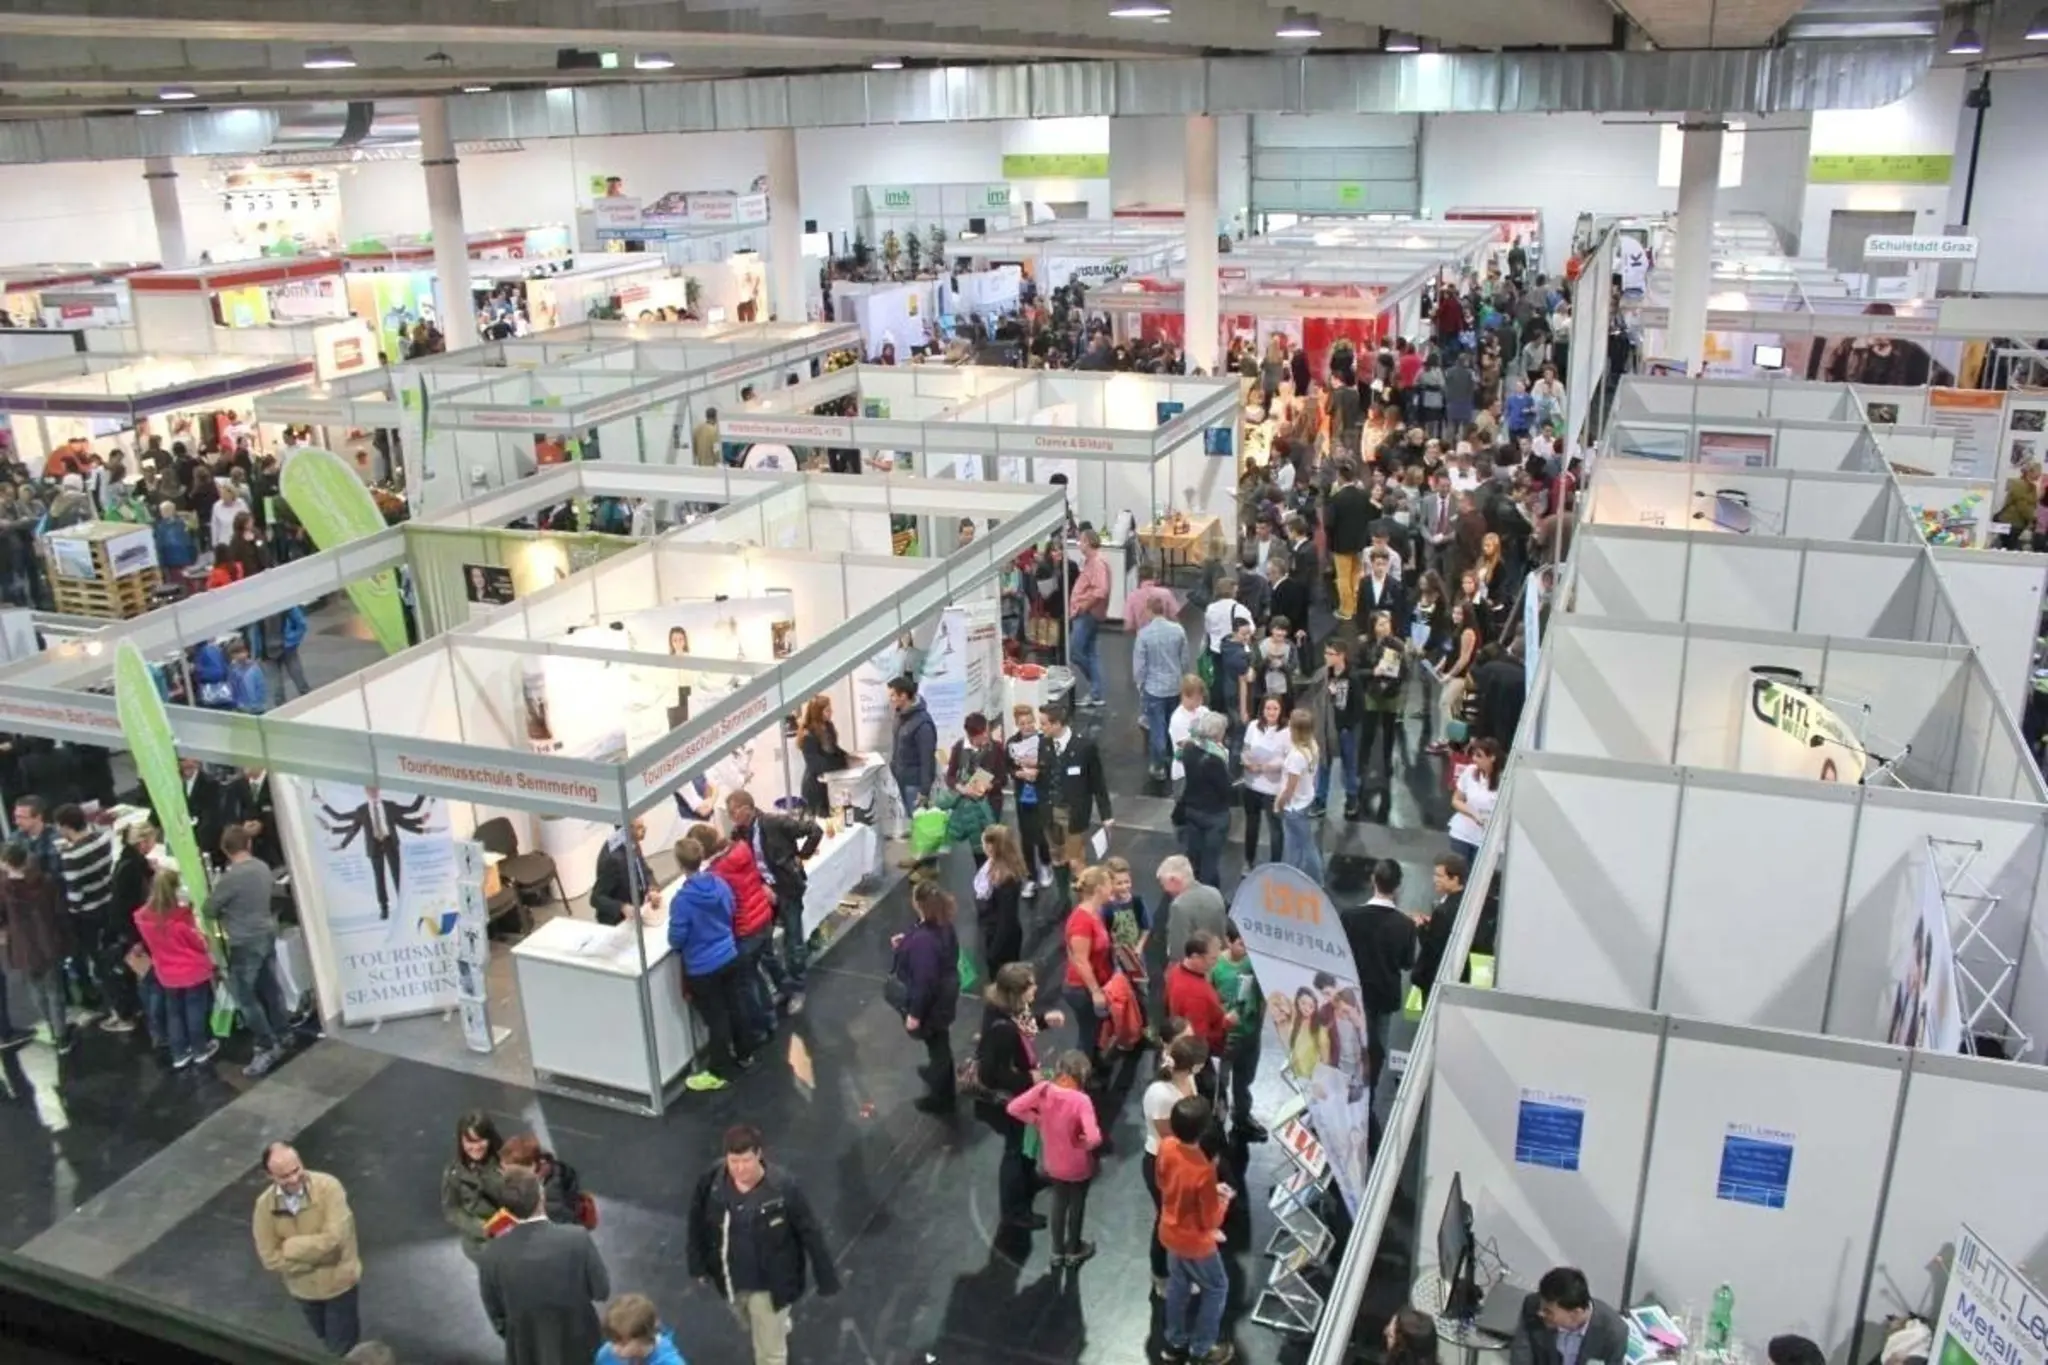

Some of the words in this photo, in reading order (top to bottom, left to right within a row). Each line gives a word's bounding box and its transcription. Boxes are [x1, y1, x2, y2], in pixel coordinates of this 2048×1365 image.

[1870, 240, 1938, 252] Schulstadt
[1942, 241, 1973, 252] Graz
[1782, 693, 1809, 728] HTL
[642, 722, 721, 786] Tourismusschule
[721, 696, 768, 735] Semmering
[398, 755, 513, 788] Tourismusschule
[516, 772, 598, 802] Semmering
[345, 977, 458, 1006] SEMMERIN
